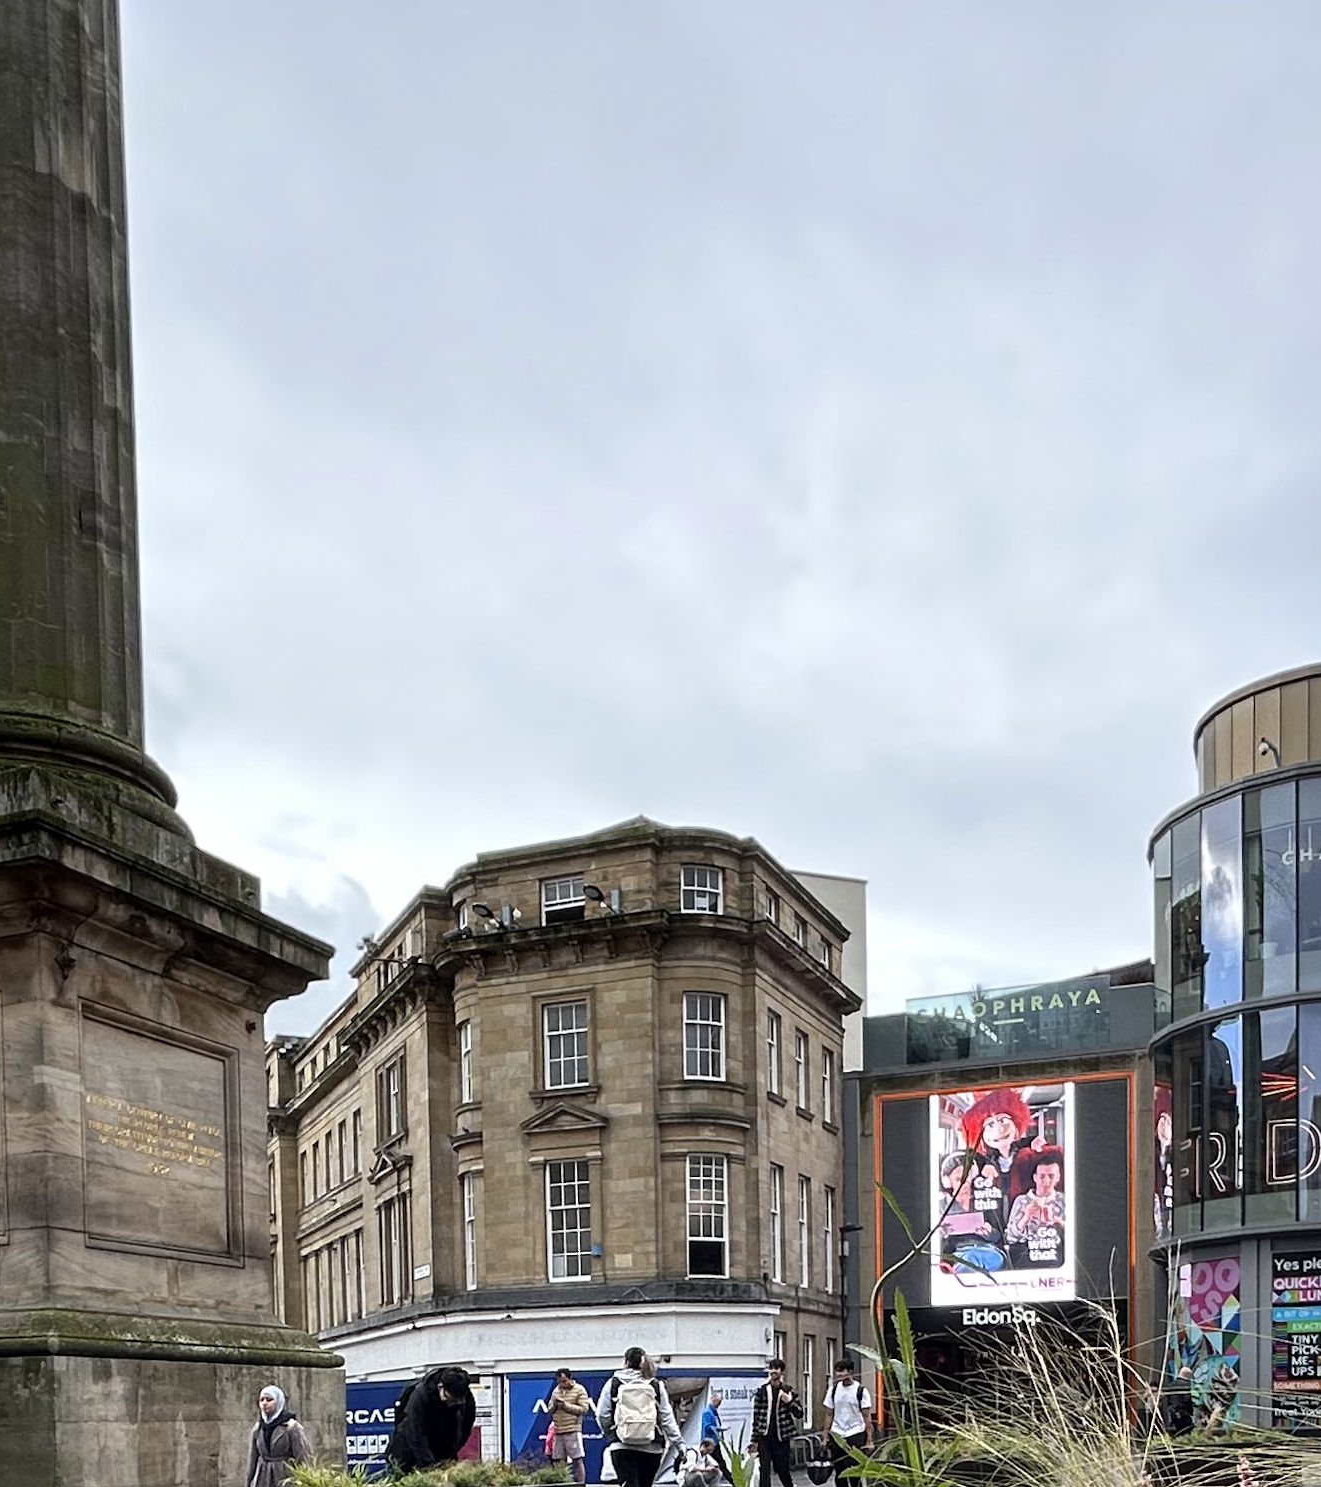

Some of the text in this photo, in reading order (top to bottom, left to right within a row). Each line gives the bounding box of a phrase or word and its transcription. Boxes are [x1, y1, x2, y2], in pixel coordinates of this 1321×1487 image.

[916, 988, 1101, 1024] CHAOPHRAYA
[973, 1176, 993, 1188] Go
[974, 1187, 1002, 1199] with
[974, 1198, 998, 1211] this
[1037, 1227, 1057, 1238] Go
[1028, 1237, 1056, 1250] with
[1029, 1249, 1057, 1261] that
[1274, 1257, 1300, 1272] Yes
[1031, 1277, 1066, 1288] LNER
[1273, 1277, 1320, 1291] QUICK
[1291, 1334, 1319, 1345] TINY
[1291, 1345, 1319, 1355] PICK
[1291, 1356, 1314, 1366] ME-
[1291, 1366, 1315, 1376] UPS
